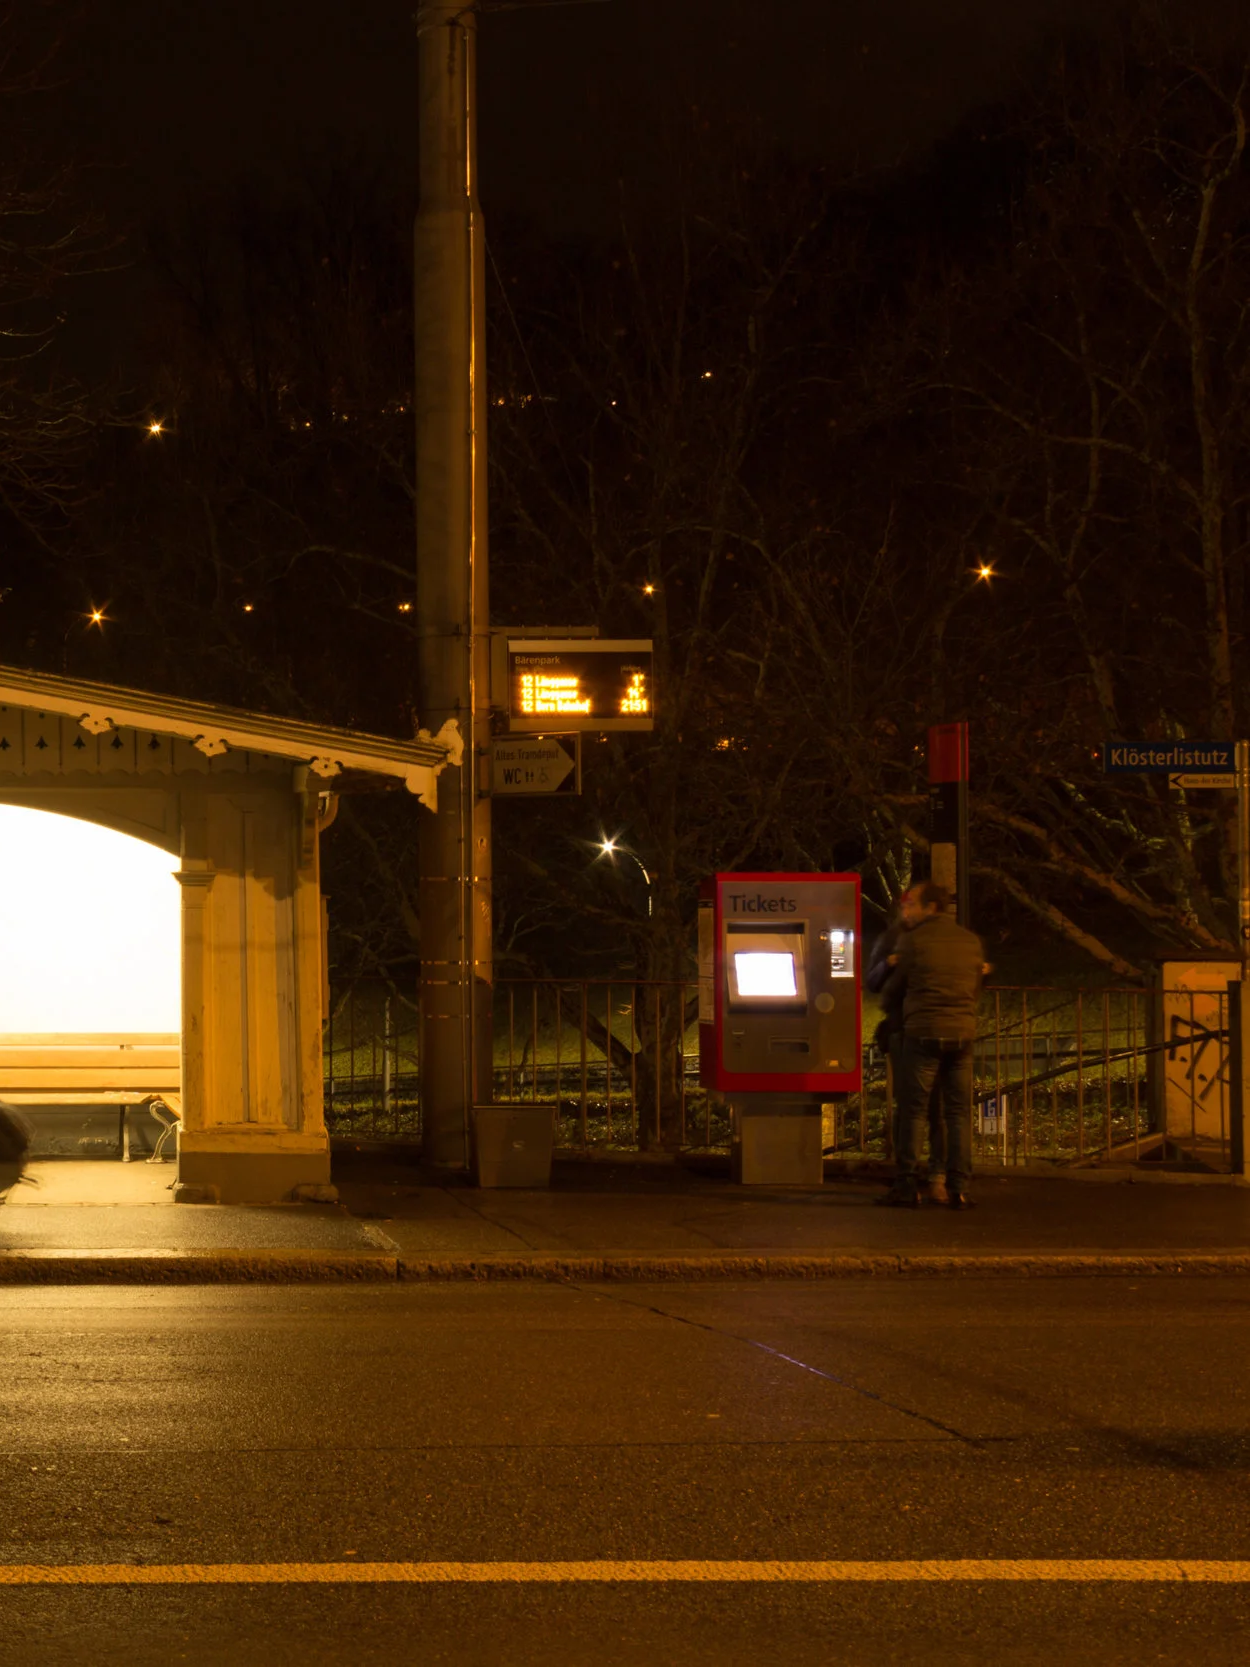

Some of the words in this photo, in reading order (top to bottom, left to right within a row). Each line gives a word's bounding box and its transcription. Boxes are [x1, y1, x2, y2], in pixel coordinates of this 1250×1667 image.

[514, 655, 561, 666] Bärenpark
[521, 675, 534, 687] 12
[521, 687, 534, 699] 12
[521, 699, 534, 711] 12
[1110, 748, 1229, 766] Klösterlistutz
[503, 768, 522, 785] WC
[729, 894, 798, 913] Tickets
